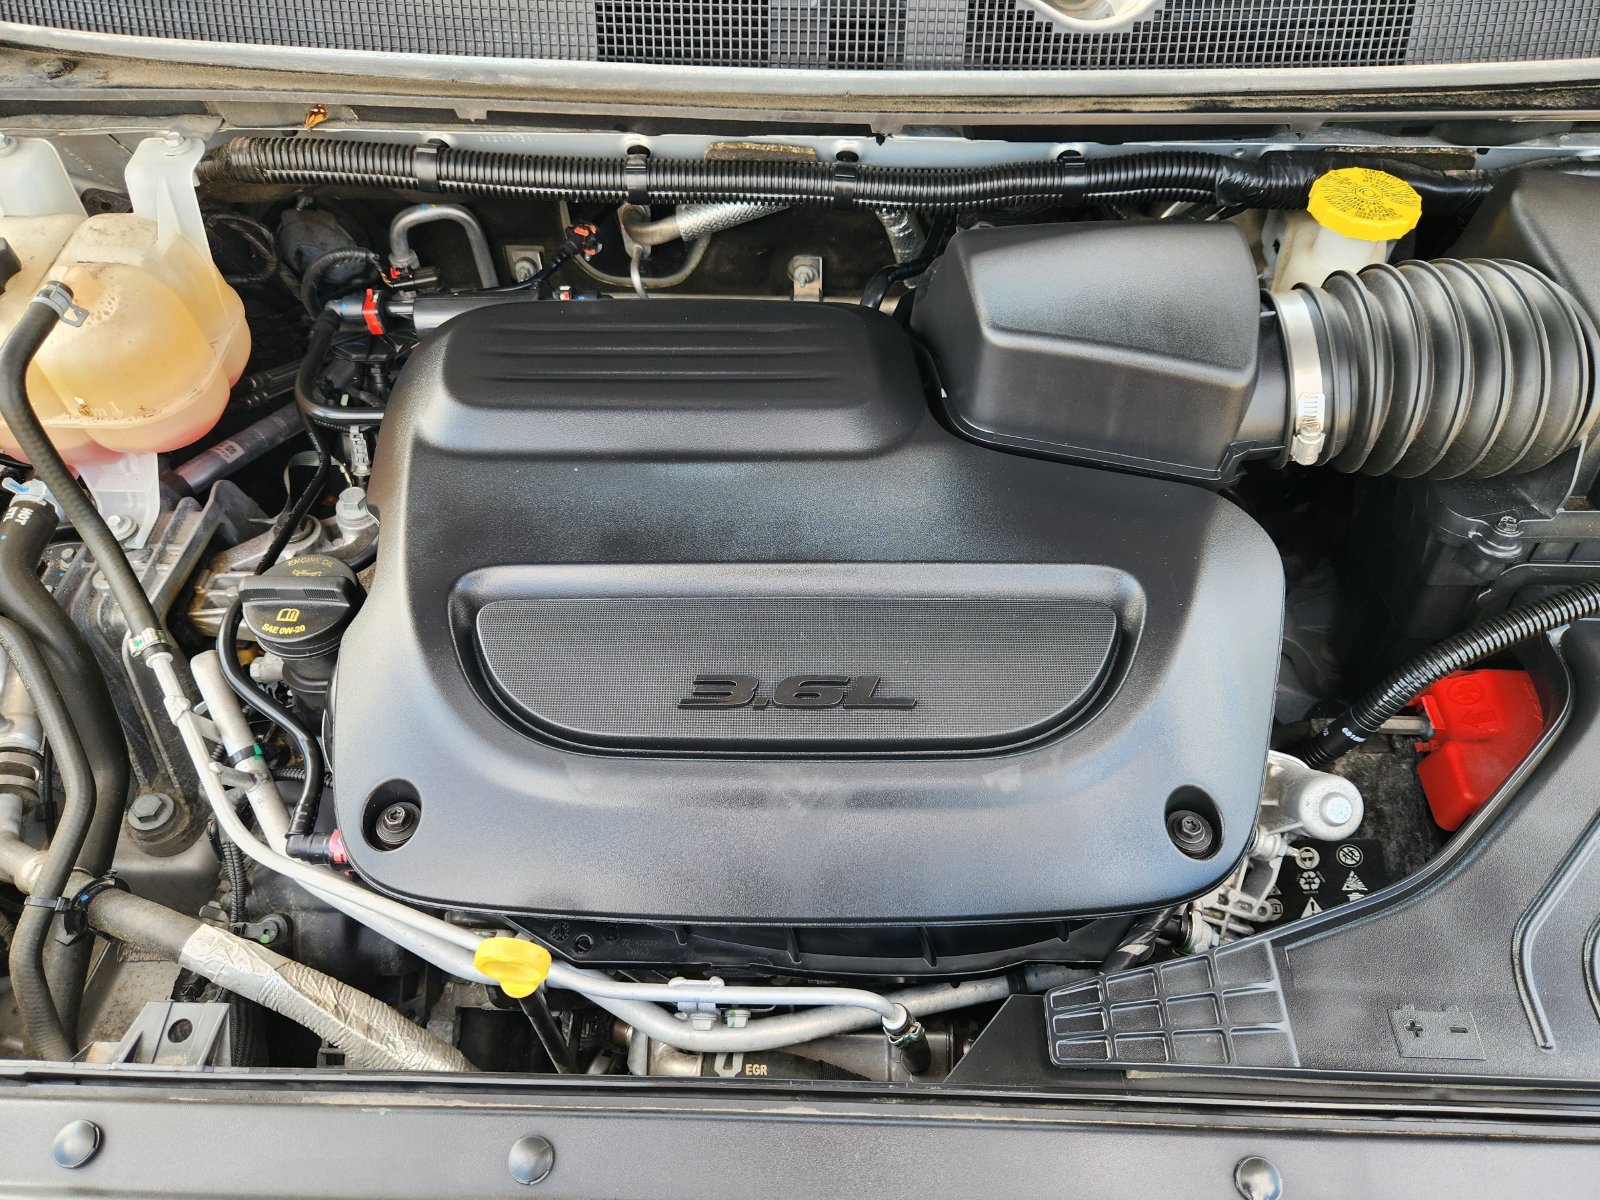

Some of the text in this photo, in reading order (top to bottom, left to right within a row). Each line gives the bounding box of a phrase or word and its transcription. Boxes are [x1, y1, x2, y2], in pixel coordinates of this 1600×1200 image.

[14, 507, 34, 526] HOT
[287, 556, 335, 569] ENGINE OIL
[261, 623, 306, 635] SAE 0W-20
[677, 674, 917, 710] 3.6L
[745, 1063, 768, 1076] EGR
